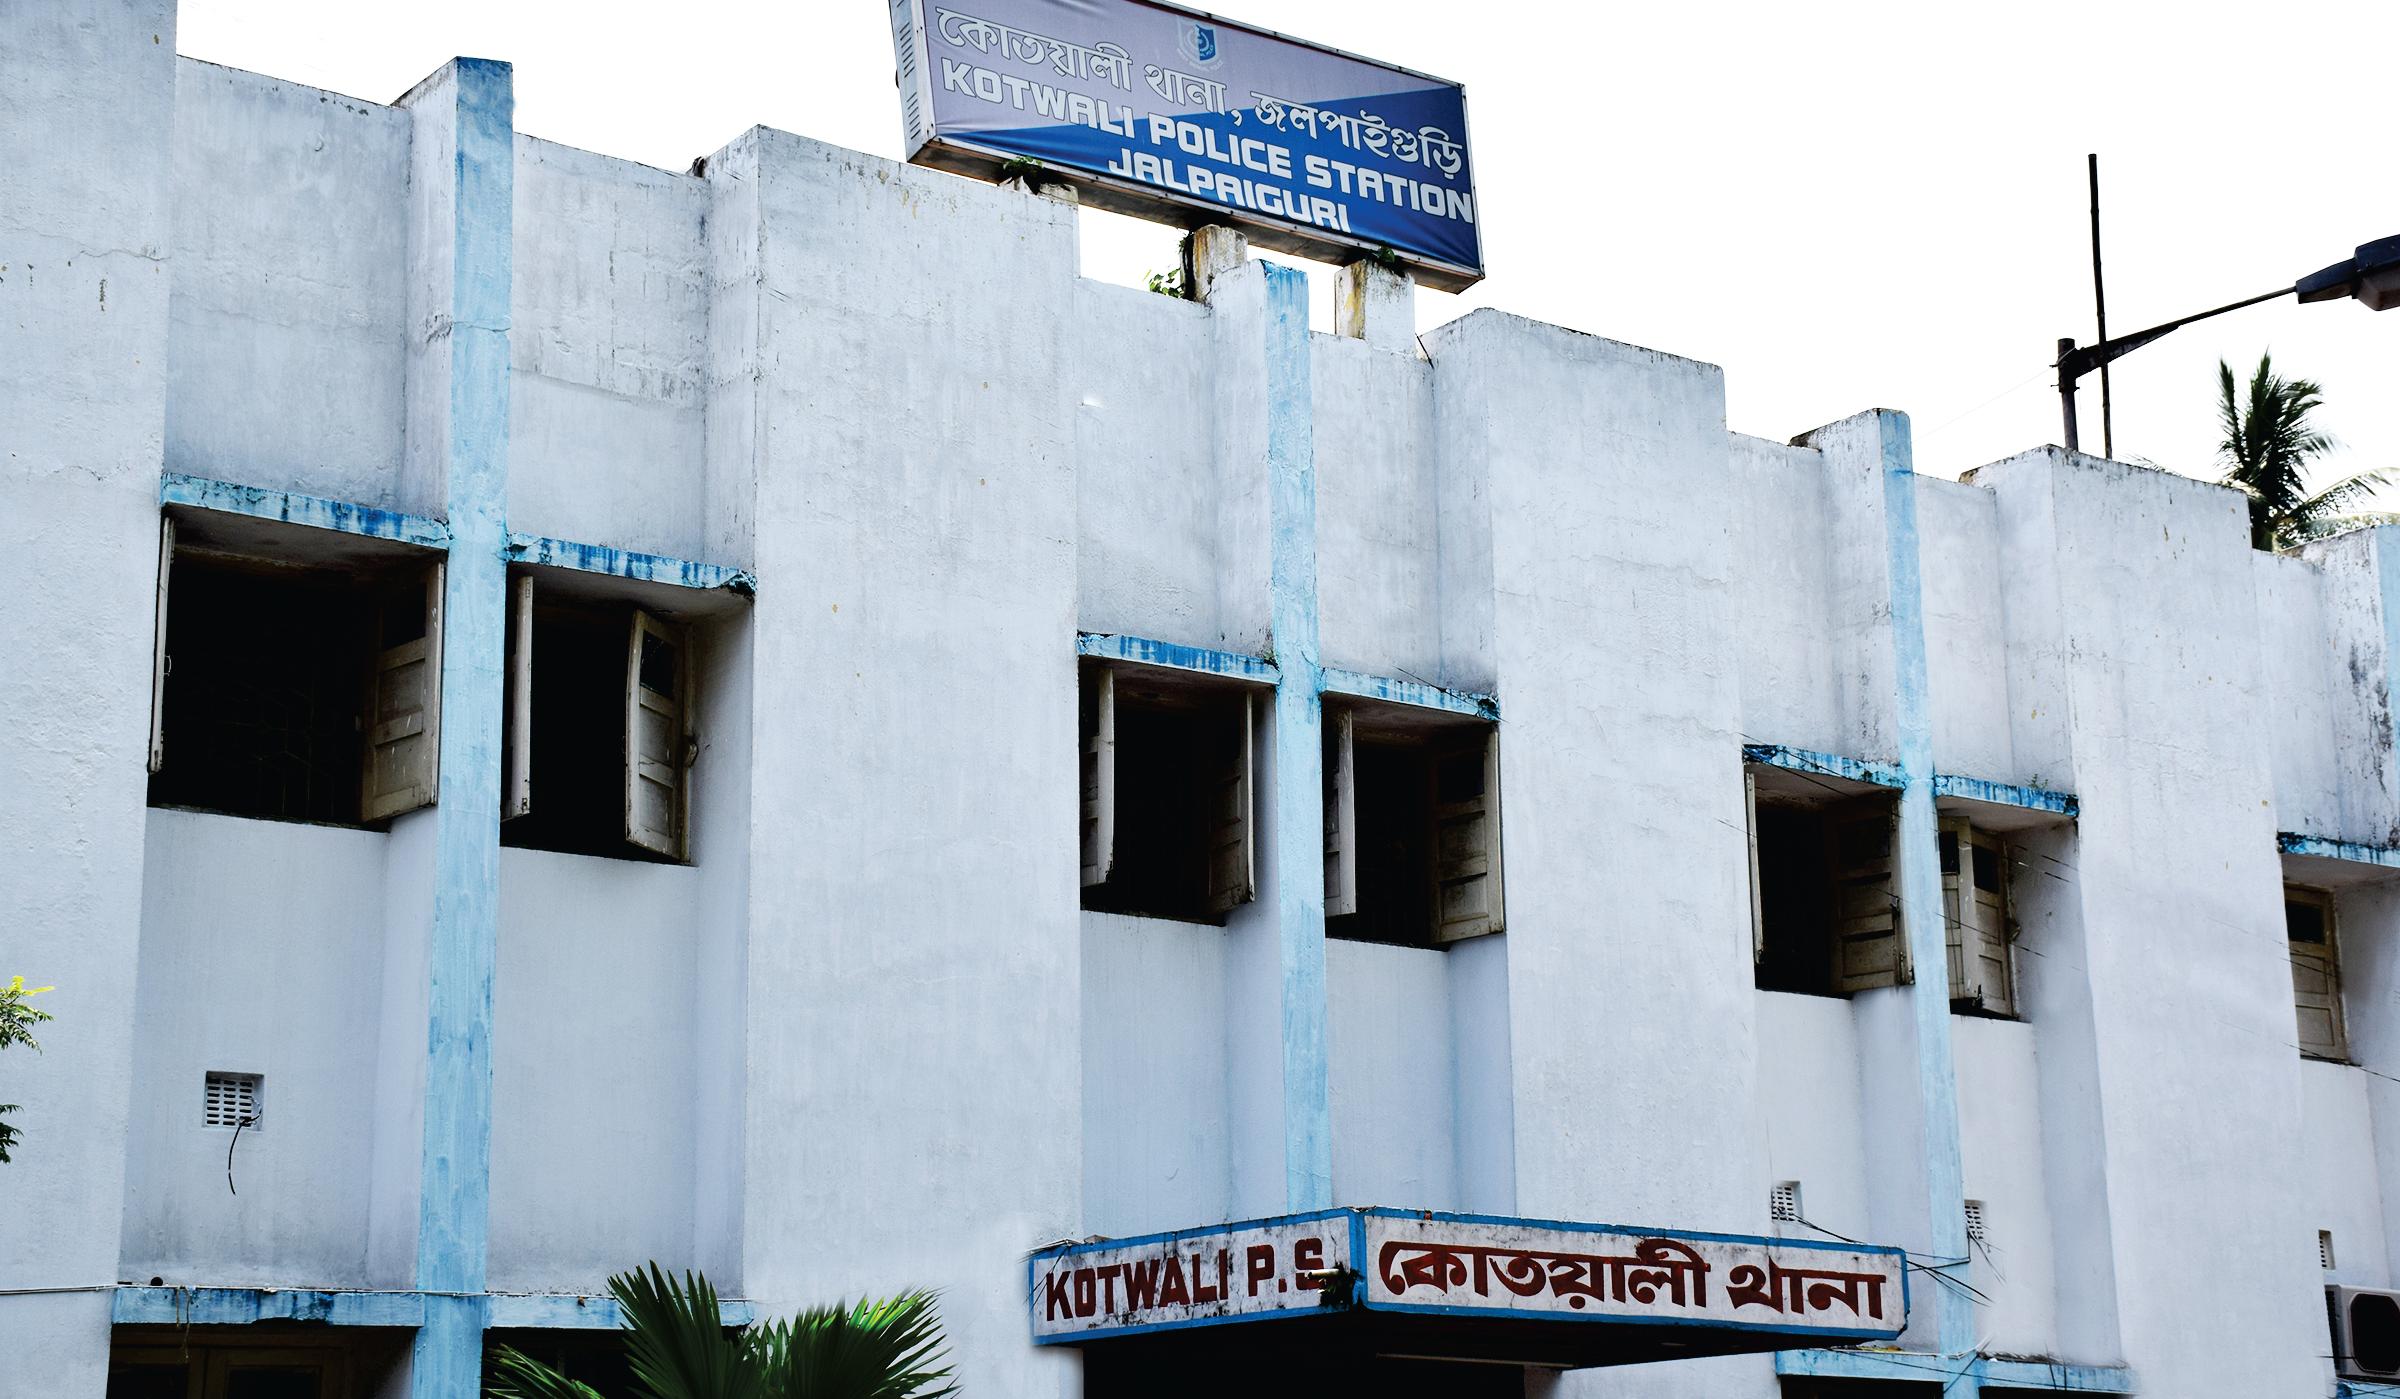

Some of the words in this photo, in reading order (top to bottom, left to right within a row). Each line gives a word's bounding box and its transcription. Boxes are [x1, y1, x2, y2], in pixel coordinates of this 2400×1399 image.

[936, 7, 1134, 92] কোতয়ালী
[1250, 91, 1463, 180] জলপাইগুড়ি
[940, 57, 1136, 139] KOTWALI
[1147, 112, 1293, 180] POLICE
[1304, 154, 1474, 224] STATION
[1108, 147, 1352, 234] JALPAIGURI
[1045, 1248, 1229, 1322] KOTWALI
[1378, 1238, 1711, 1310] কোতয়ালী
[1725, 1256, 1887, 1320] থানা
